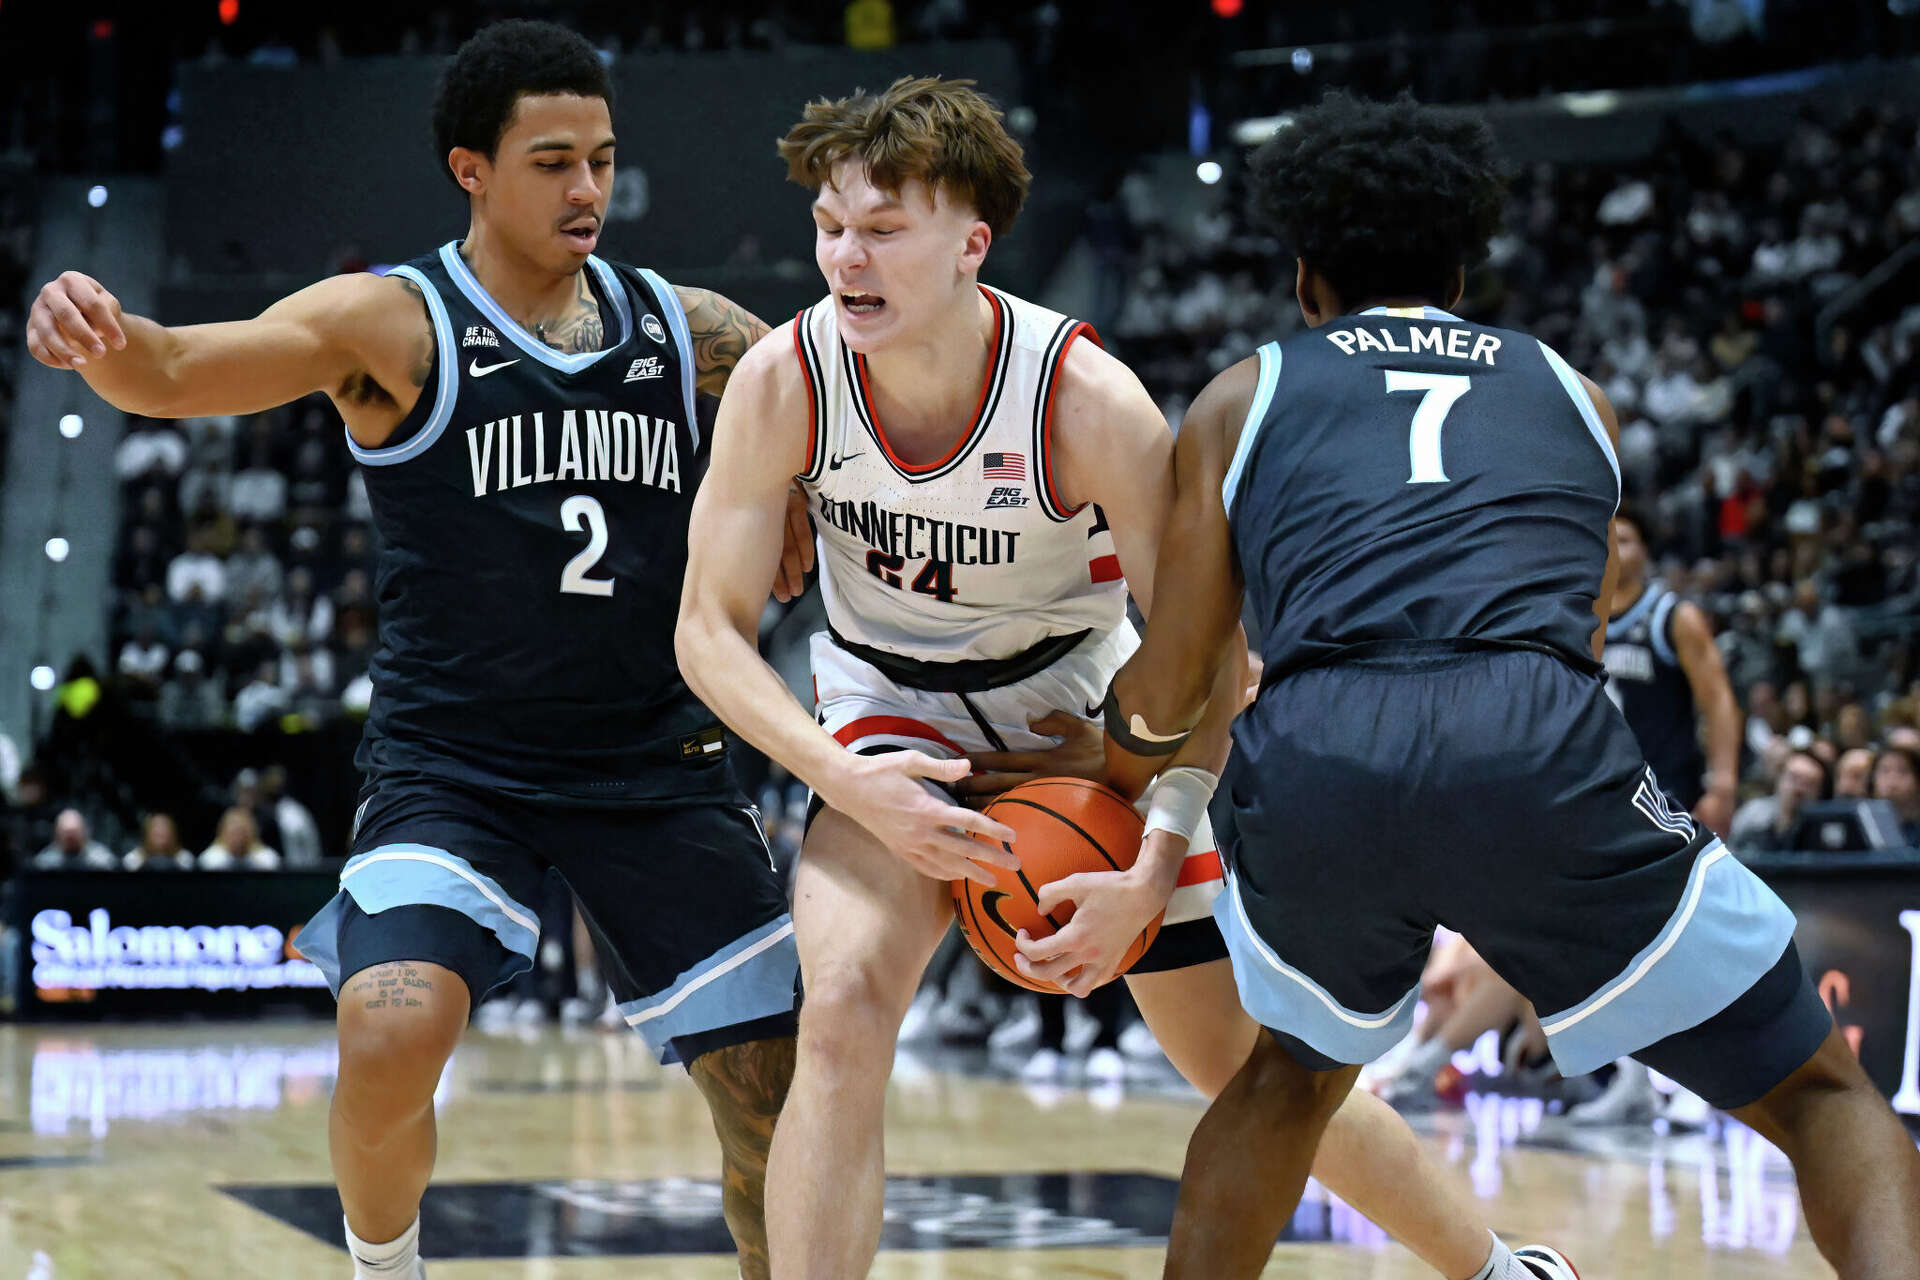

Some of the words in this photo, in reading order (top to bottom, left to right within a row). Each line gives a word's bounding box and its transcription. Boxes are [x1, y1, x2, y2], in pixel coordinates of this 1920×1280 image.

[465, 326, 480, 337] BE
[481, 326, 497, 339] TH
[1326, 326, 1502, 367] PALMER
[630, 356, 658, 369] BIG
[626, 365, 665, 378] EAST
[1384, 369, 1472, 484] 7
[465, 409, 681, 498] VILLANOVA
[991, 487, 1022, 497] BIG
[986, 496, 1031, 506] EAST
[559, 494, 616, 597] 2
